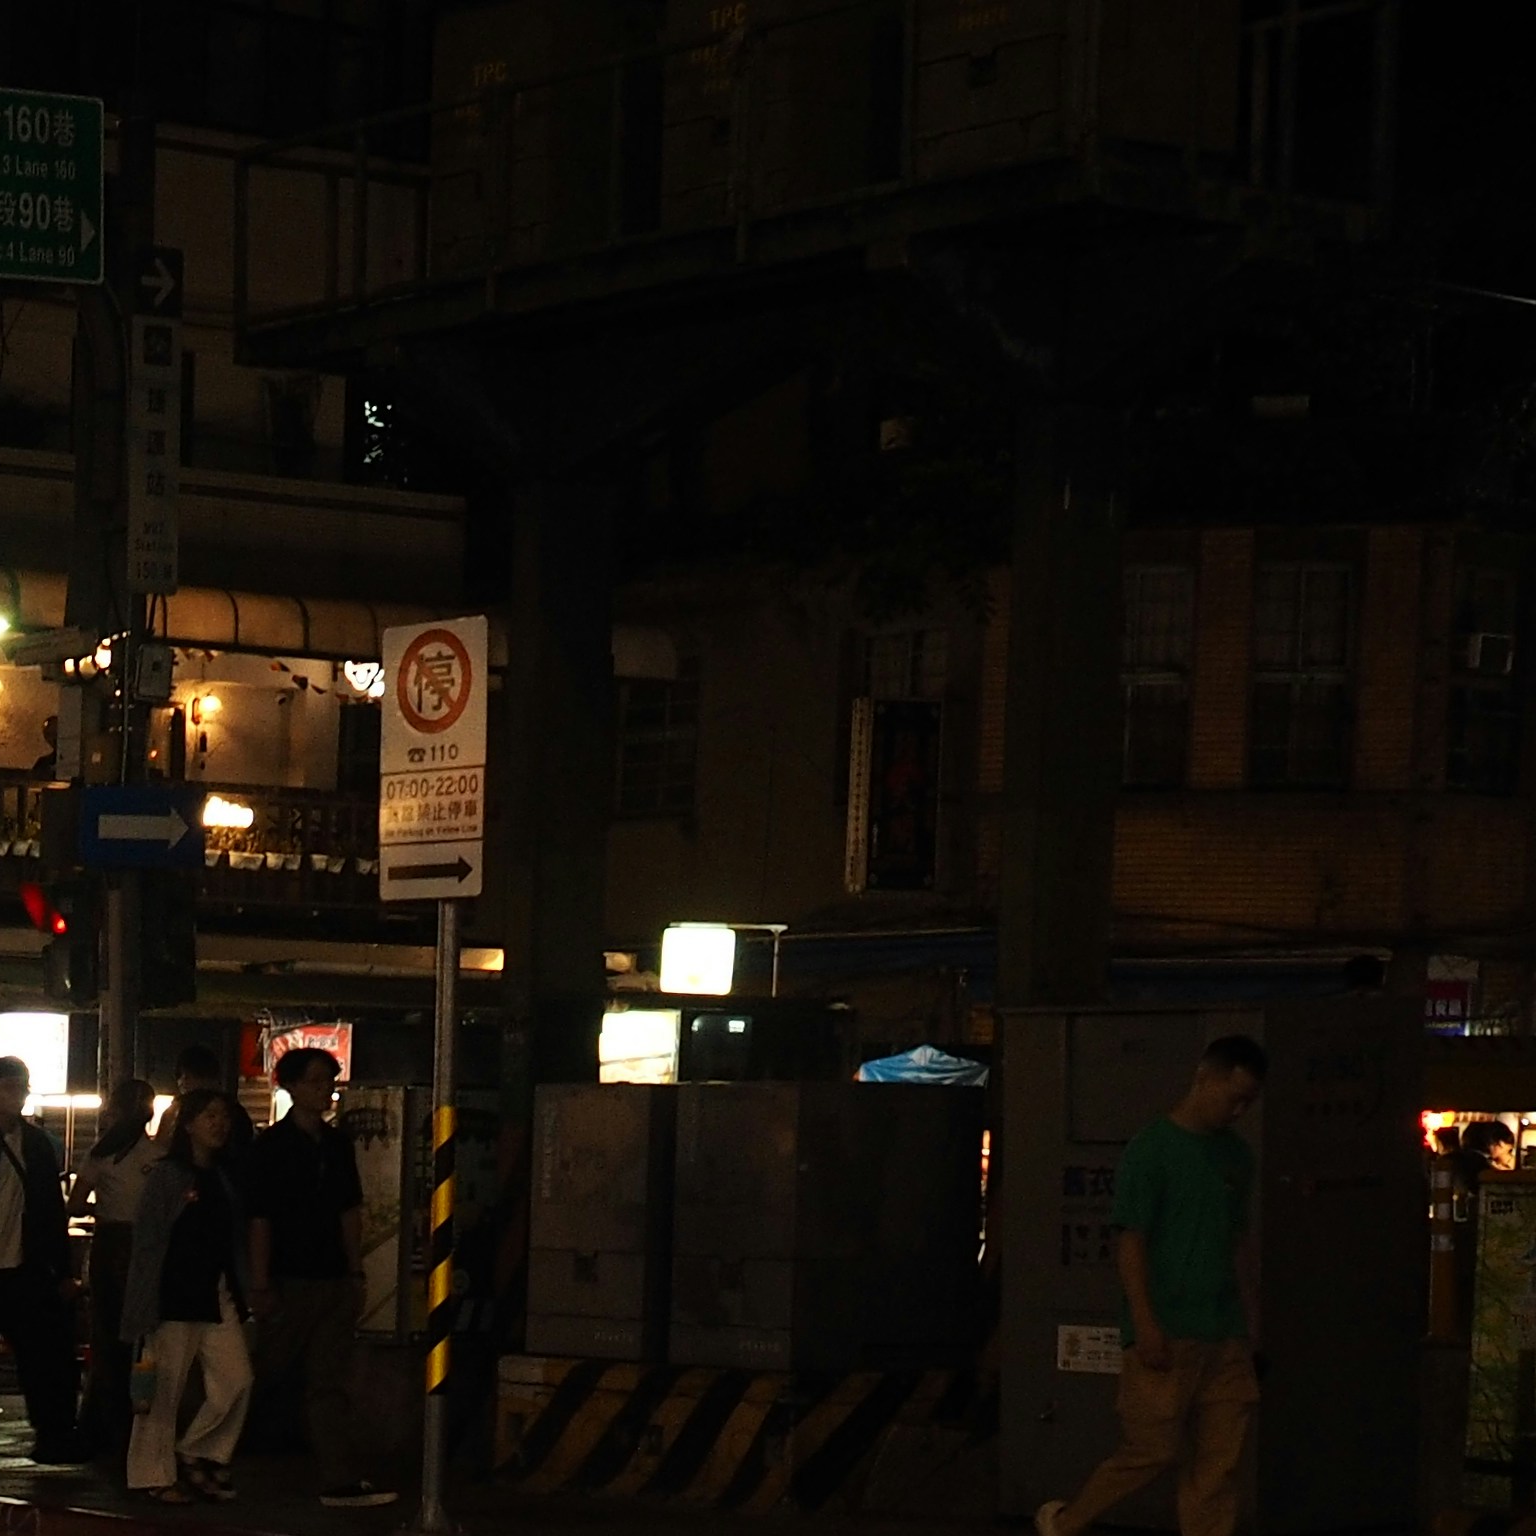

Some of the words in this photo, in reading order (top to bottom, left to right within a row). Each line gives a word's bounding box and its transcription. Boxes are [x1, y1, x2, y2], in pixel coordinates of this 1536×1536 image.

[3, 154, 11, 175] 3
[16, 154, 49, 178] Lane
[55, 159, 76, 181] 160
[3, 241, 14, 261] 4
[20, 242, 54, 265] Lane
[58, 245, 76, 268] 90
[414, 652, 456, 713] 停
[431, 743, 459, 762] 110
[386, 774, 478, 800] 07:00-22:00
